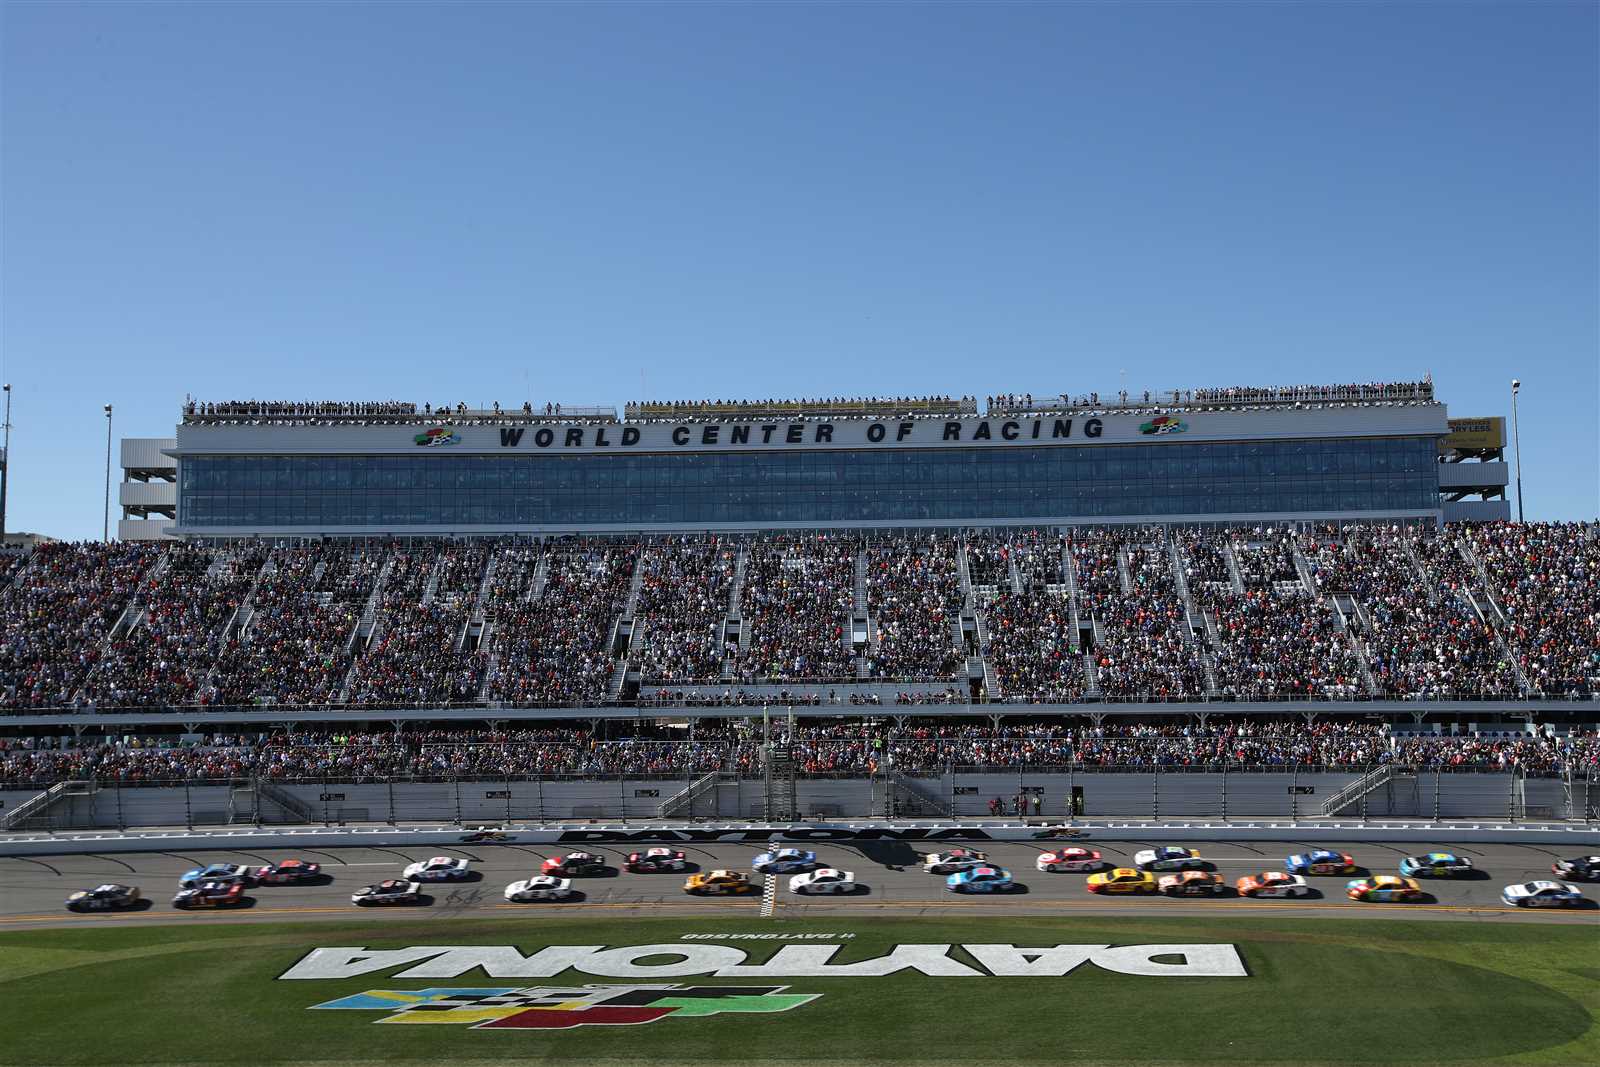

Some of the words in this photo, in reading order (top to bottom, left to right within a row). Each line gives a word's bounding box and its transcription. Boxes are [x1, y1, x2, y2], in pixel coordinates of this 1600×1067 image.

[500, 428, 641, 447] WORLD
[672, 423, 834, 447] CENTER
[866, 422, 914, 443] OF
[942, 418, 1105, 441] RACING
[557, 827, 993, 842] DAYTONA
[279, 943, 1248, 980] DAYTONA
